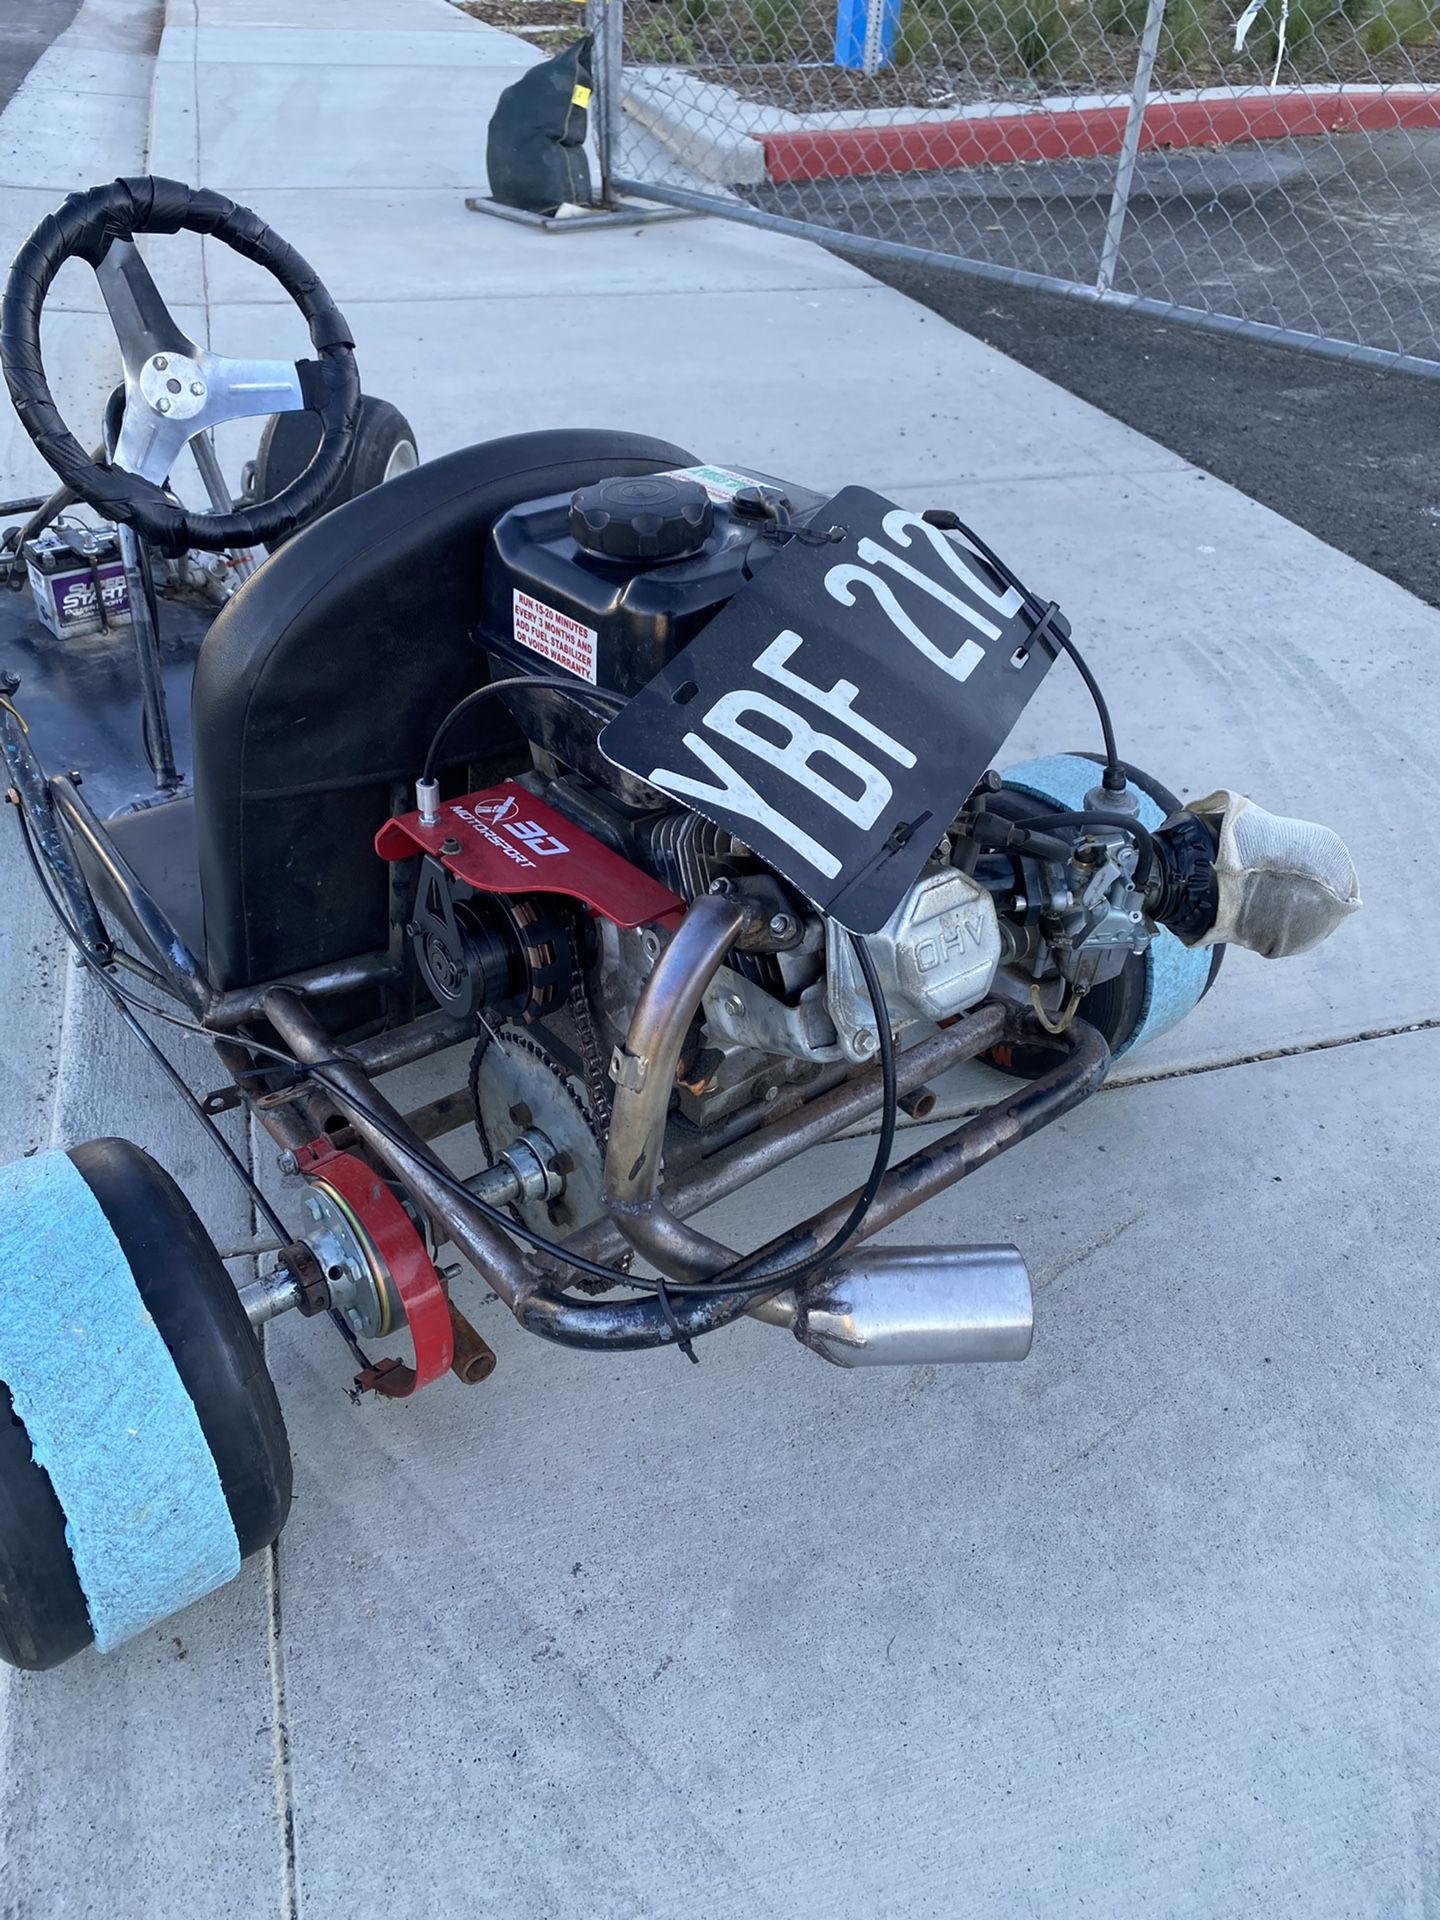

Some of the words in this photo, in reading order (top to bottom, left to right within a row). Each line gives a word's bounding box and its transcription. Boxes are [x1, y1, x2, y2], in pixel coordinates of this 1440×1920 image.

[63, 585, 127, 610] START
[518, 594, 533, 609] RUN
[535, 603, 553, 620] 15-20
[555, 613, 588, 638] MINUTES
[515, 605, 537, 623] EVERY
[538, 617, 543, 628] 3
[544, 620, 575, 645] MONTHS
[576, 639, 593, 654] AND
[515, 618, 529, 632] ADD
[531, 626, 549, 643] FUEL
[550, 636, 592, 667] STABILIZER
[516, 631, 527, 643] OR
[528, 637, 549, 655] VOIDS
[648, 628, 918, 881] YBF
[823, 509, 1026, 683] 212
[449, 805, 537, 868] MOTORSPORT
[913, 914, 984, 973] OHV
